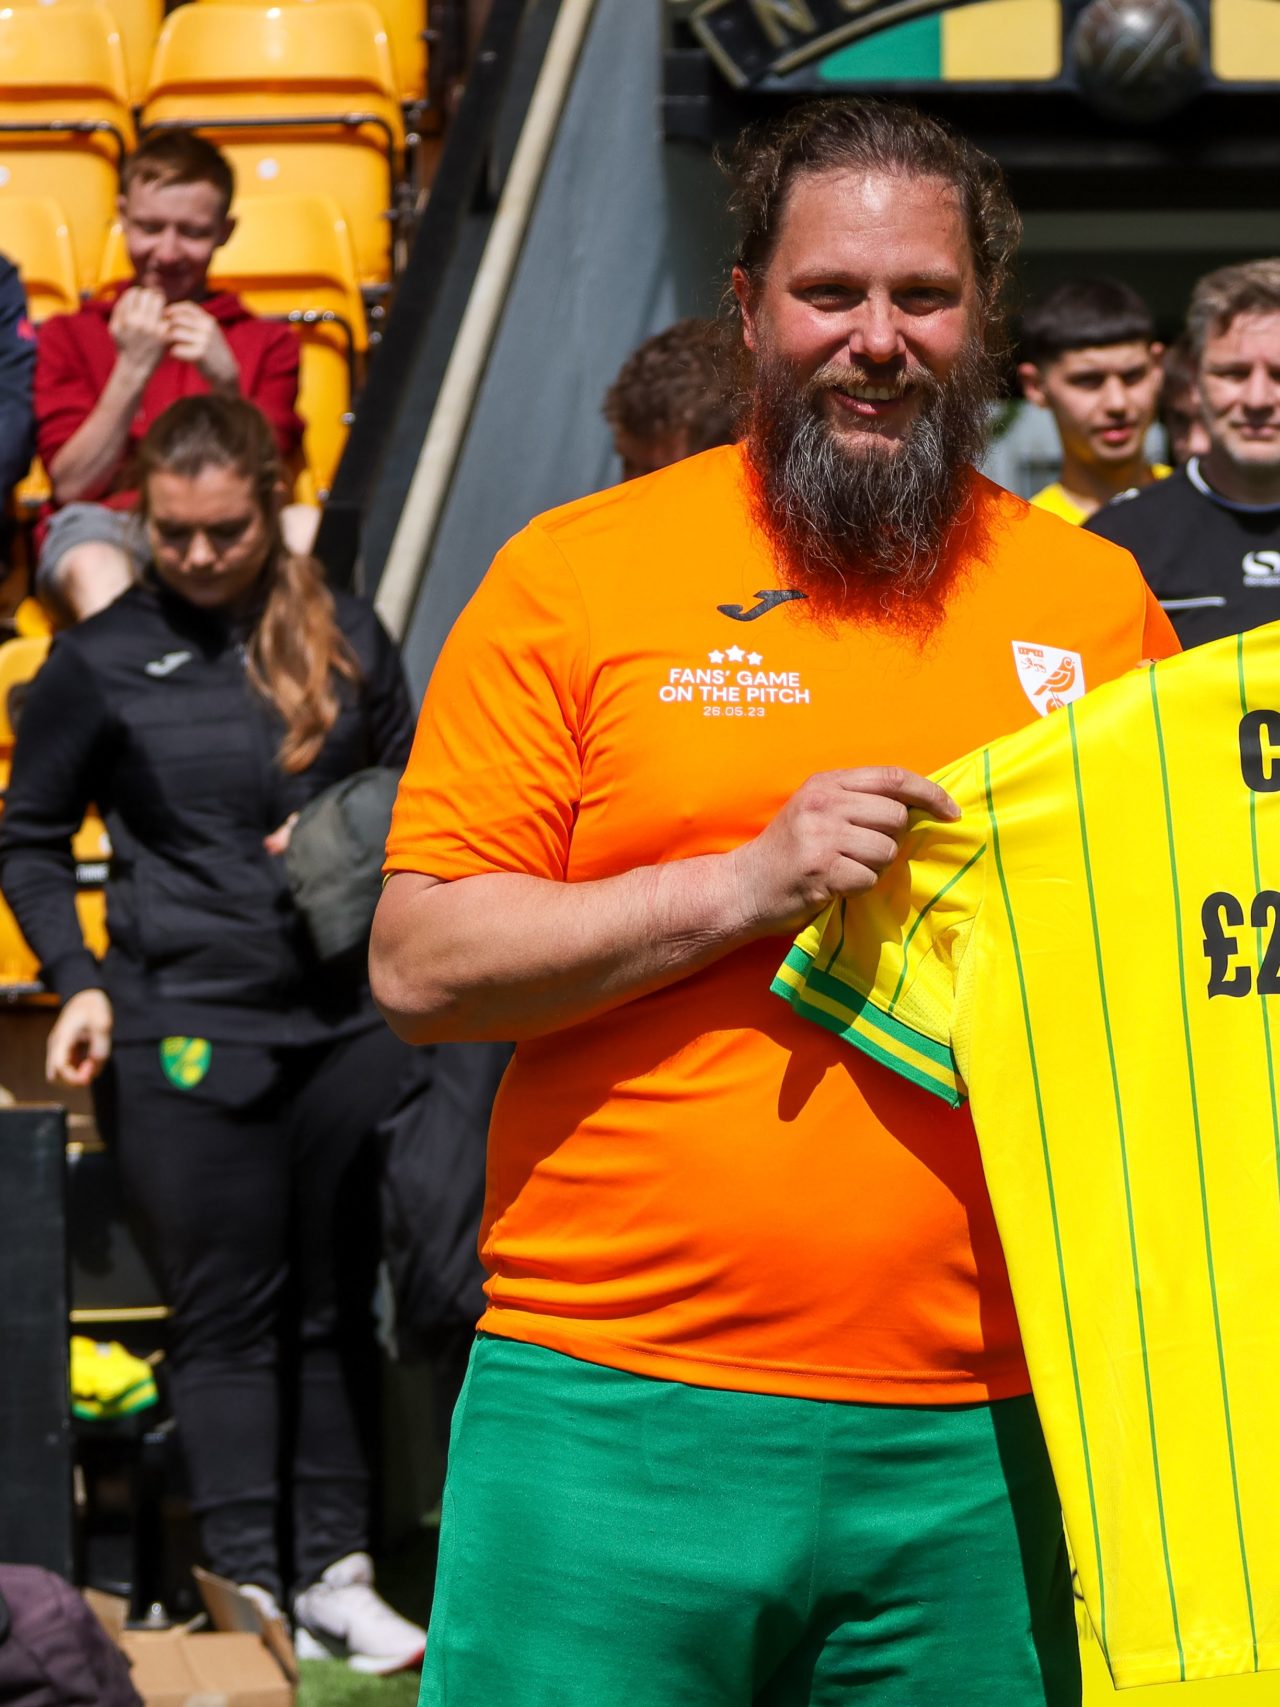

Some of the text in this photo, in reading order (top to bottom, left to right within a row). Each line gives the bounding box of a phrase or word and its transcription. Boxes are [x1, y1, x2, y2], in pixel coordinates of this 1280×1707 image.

[736, 670, 800, 687] GAME
[658, 685, 811, 704] ON THE PITCH
